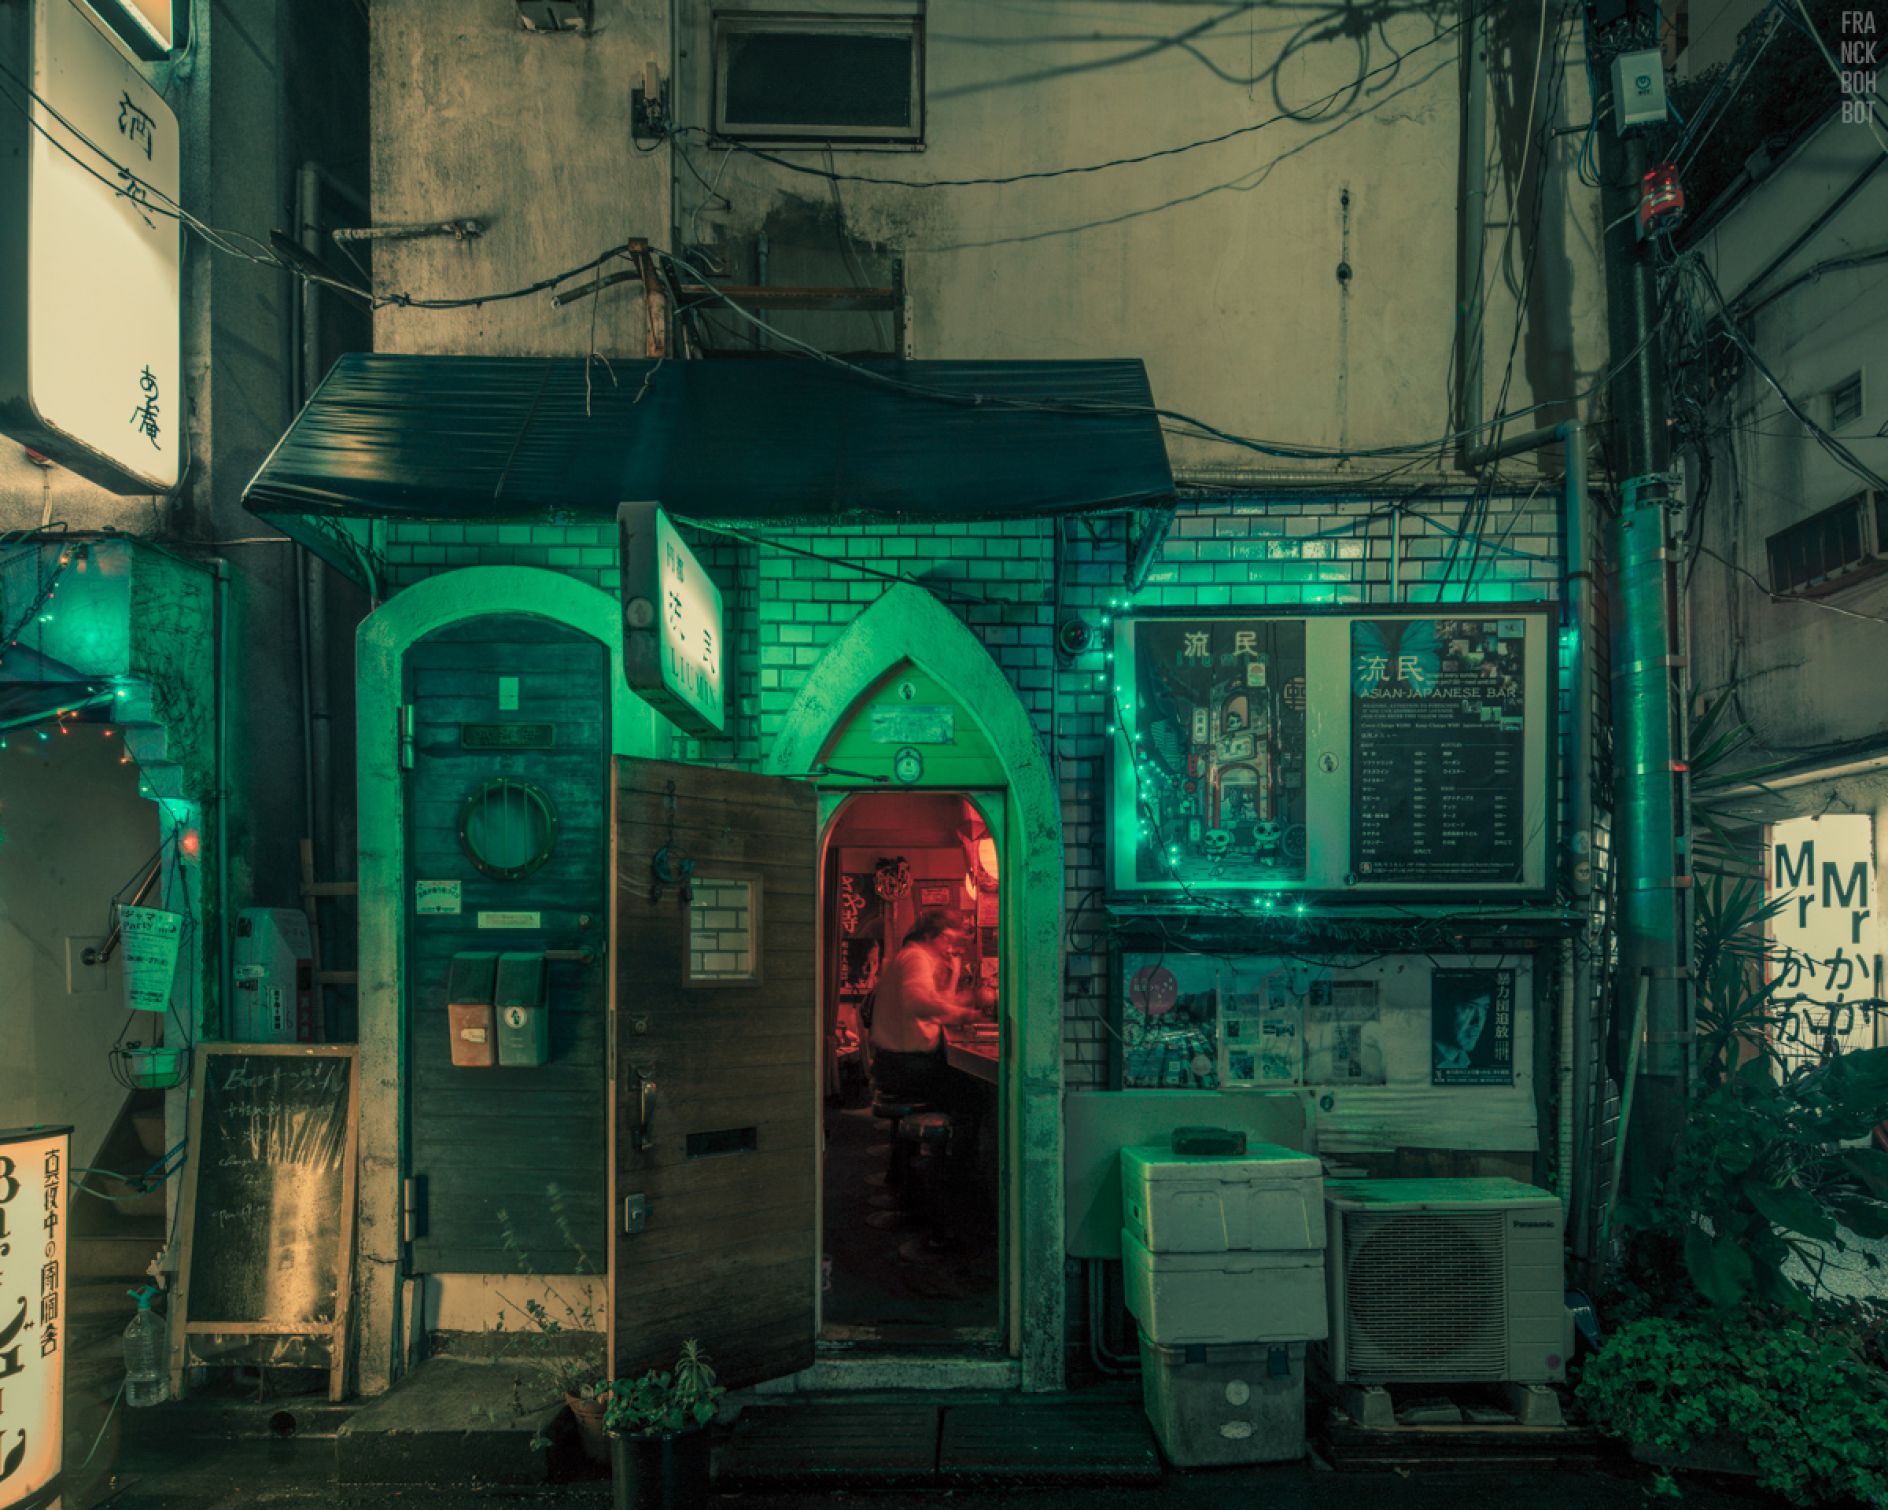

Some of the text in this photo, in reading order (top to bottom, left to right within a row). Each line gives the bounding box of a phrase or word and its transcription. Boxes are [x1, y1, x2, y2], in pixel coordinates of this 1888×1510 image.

[1184, 631, 1258, 657] 流民
[1357, 655, 1425, 682] 流民
[1360, 687, 1518, 699] ASIAN-JAPANESE BAR
[1512, 1220, 1555, 1229] Panasonic
